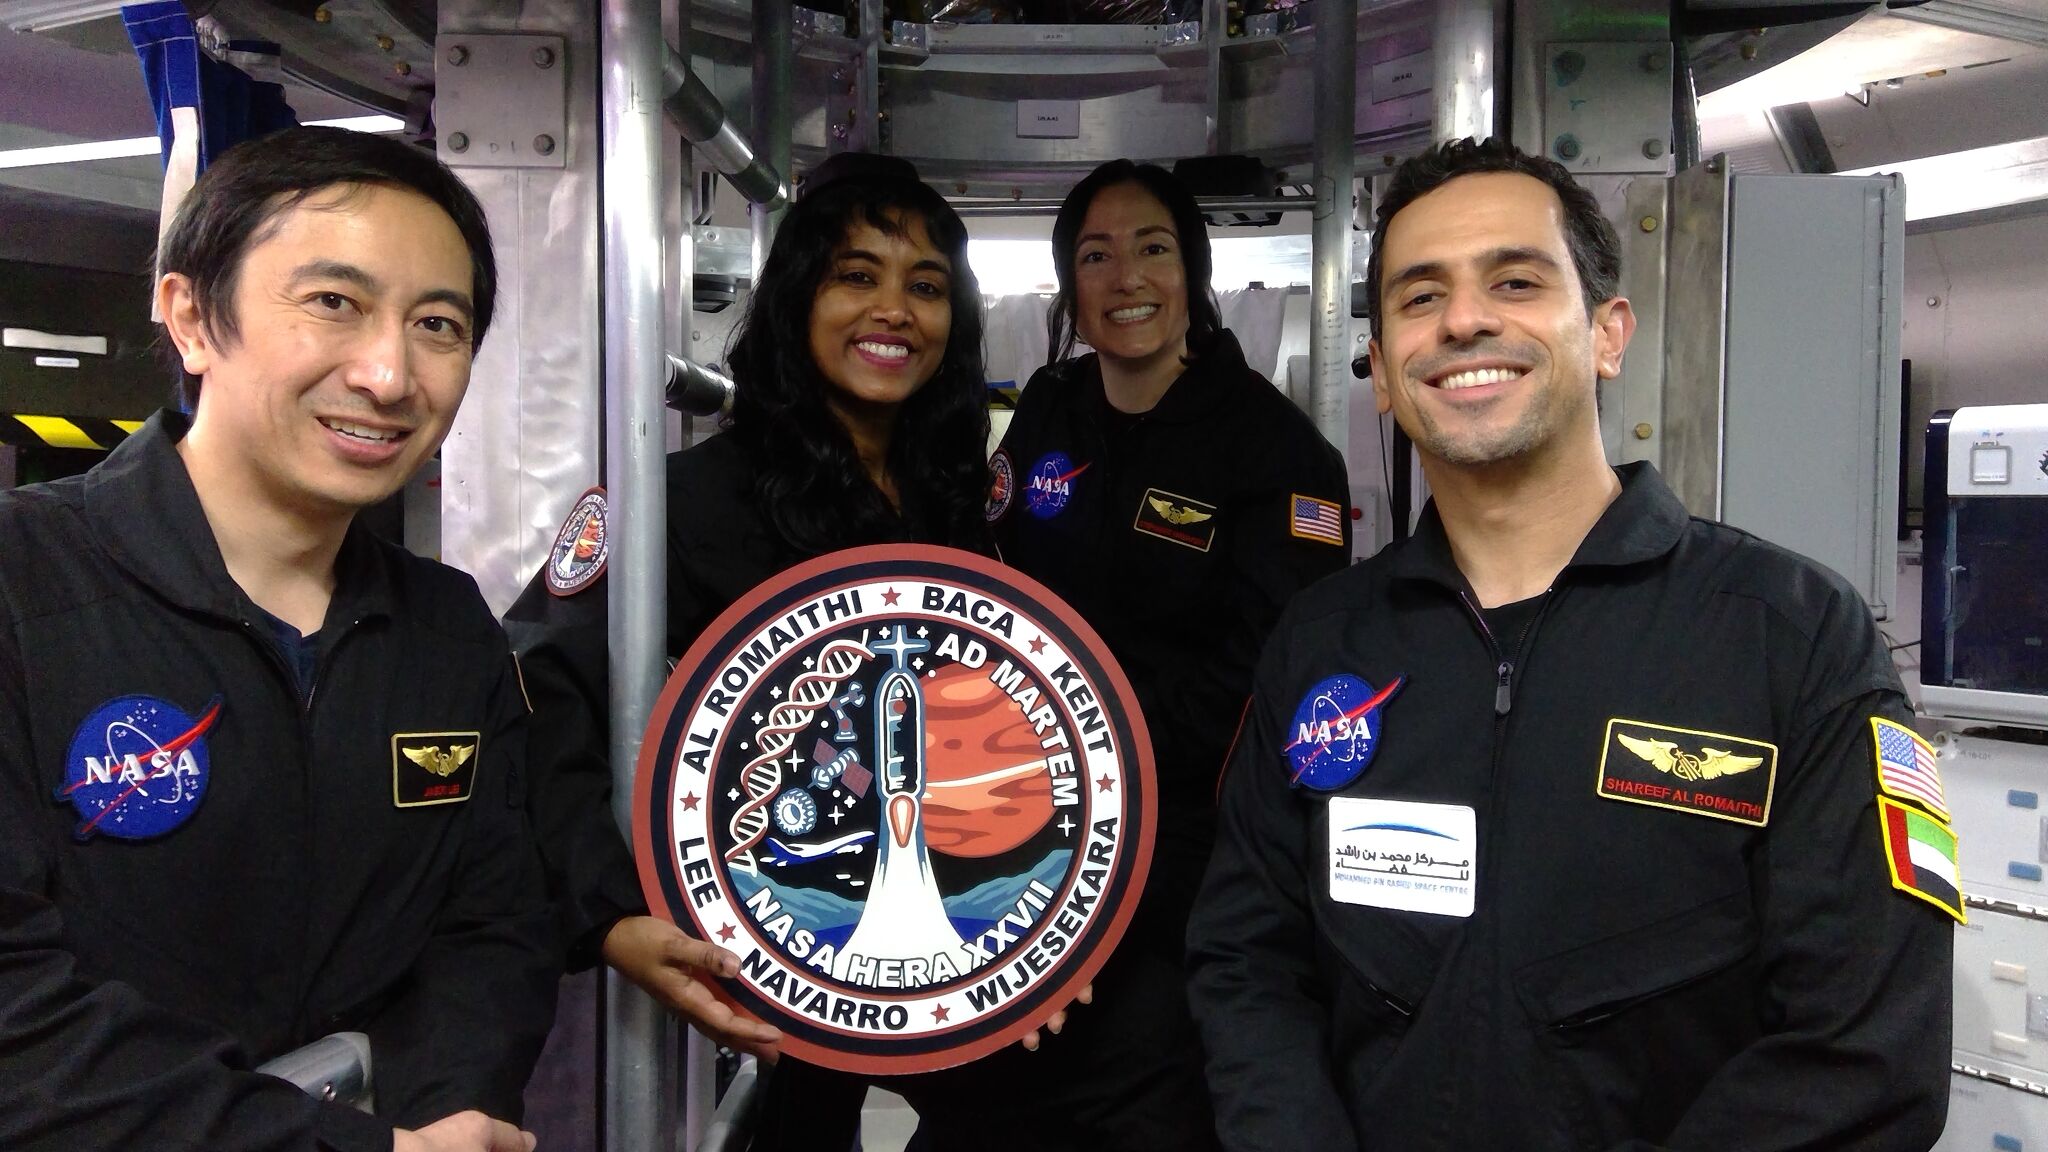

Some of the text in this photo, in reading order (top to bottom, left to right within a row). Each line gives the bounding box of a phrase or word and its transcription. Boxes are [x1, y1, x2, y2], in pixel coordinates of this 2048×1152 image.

[1031, 475, 1070, 496] NASA
[921, 586, 1015, 640] BACA
[683, 589, 863, 775] AL ROMAITHI
[1050, 662, 1114, 755] KENT
[935, 633, 1080, 808] AD MARTEM
[1298, 717, 1372, 744] NASA
[84, 748, 201, 785] NASA
[1606, 777, 1762, 818] SHAREEF AL ROMAITHI
[679, 836, 722, 909] LEE
[1335, 845, 1361, 859] راشد
[1362, 849, 1376, 861] بن
[1380, 852, 1412, 862] محمد
[745, 879, 1056, 989] NASA HERA XXVII
[965, 816, 1119, 1015] WIJESEKARA
[739, 947, 909, 1031] NAVARRO
